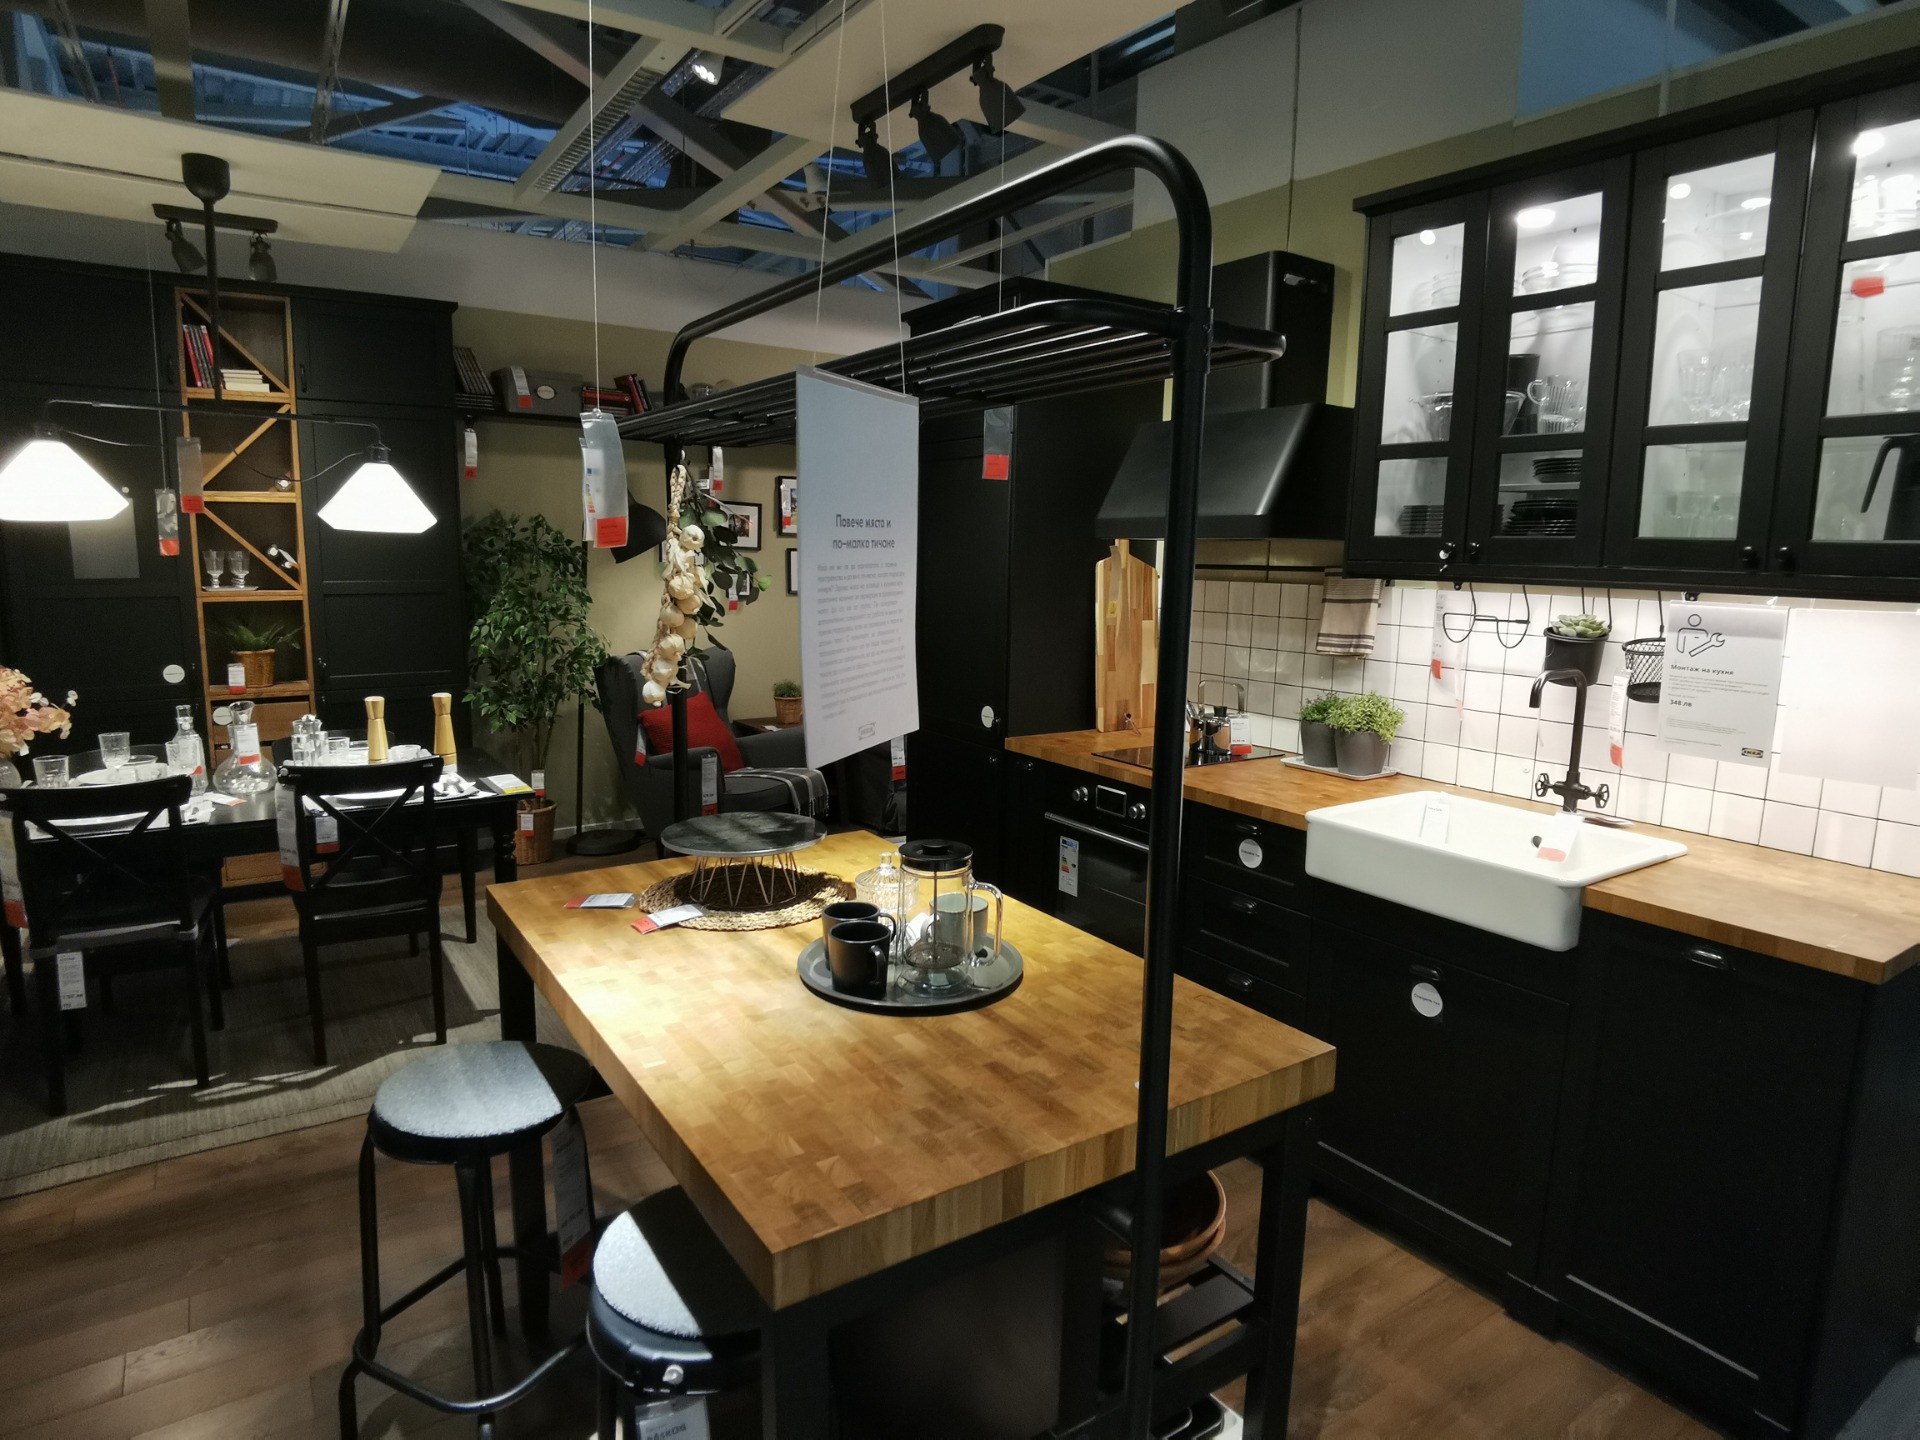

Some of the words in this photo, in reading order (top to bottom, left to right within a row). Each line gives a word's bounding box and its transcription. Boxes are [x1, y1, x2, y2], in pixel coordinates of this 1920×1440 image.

[835, 514, 863, 528] Повече
[865, 519, 885, 528] място
[886, 519, 892, 528] и
[832, 539, 869, 549] по-малко
[871, 539, 895, 549] тичане
[1670, 664, 1699, 672] Монтаж
[1682, 700, 1692, 708] лв
